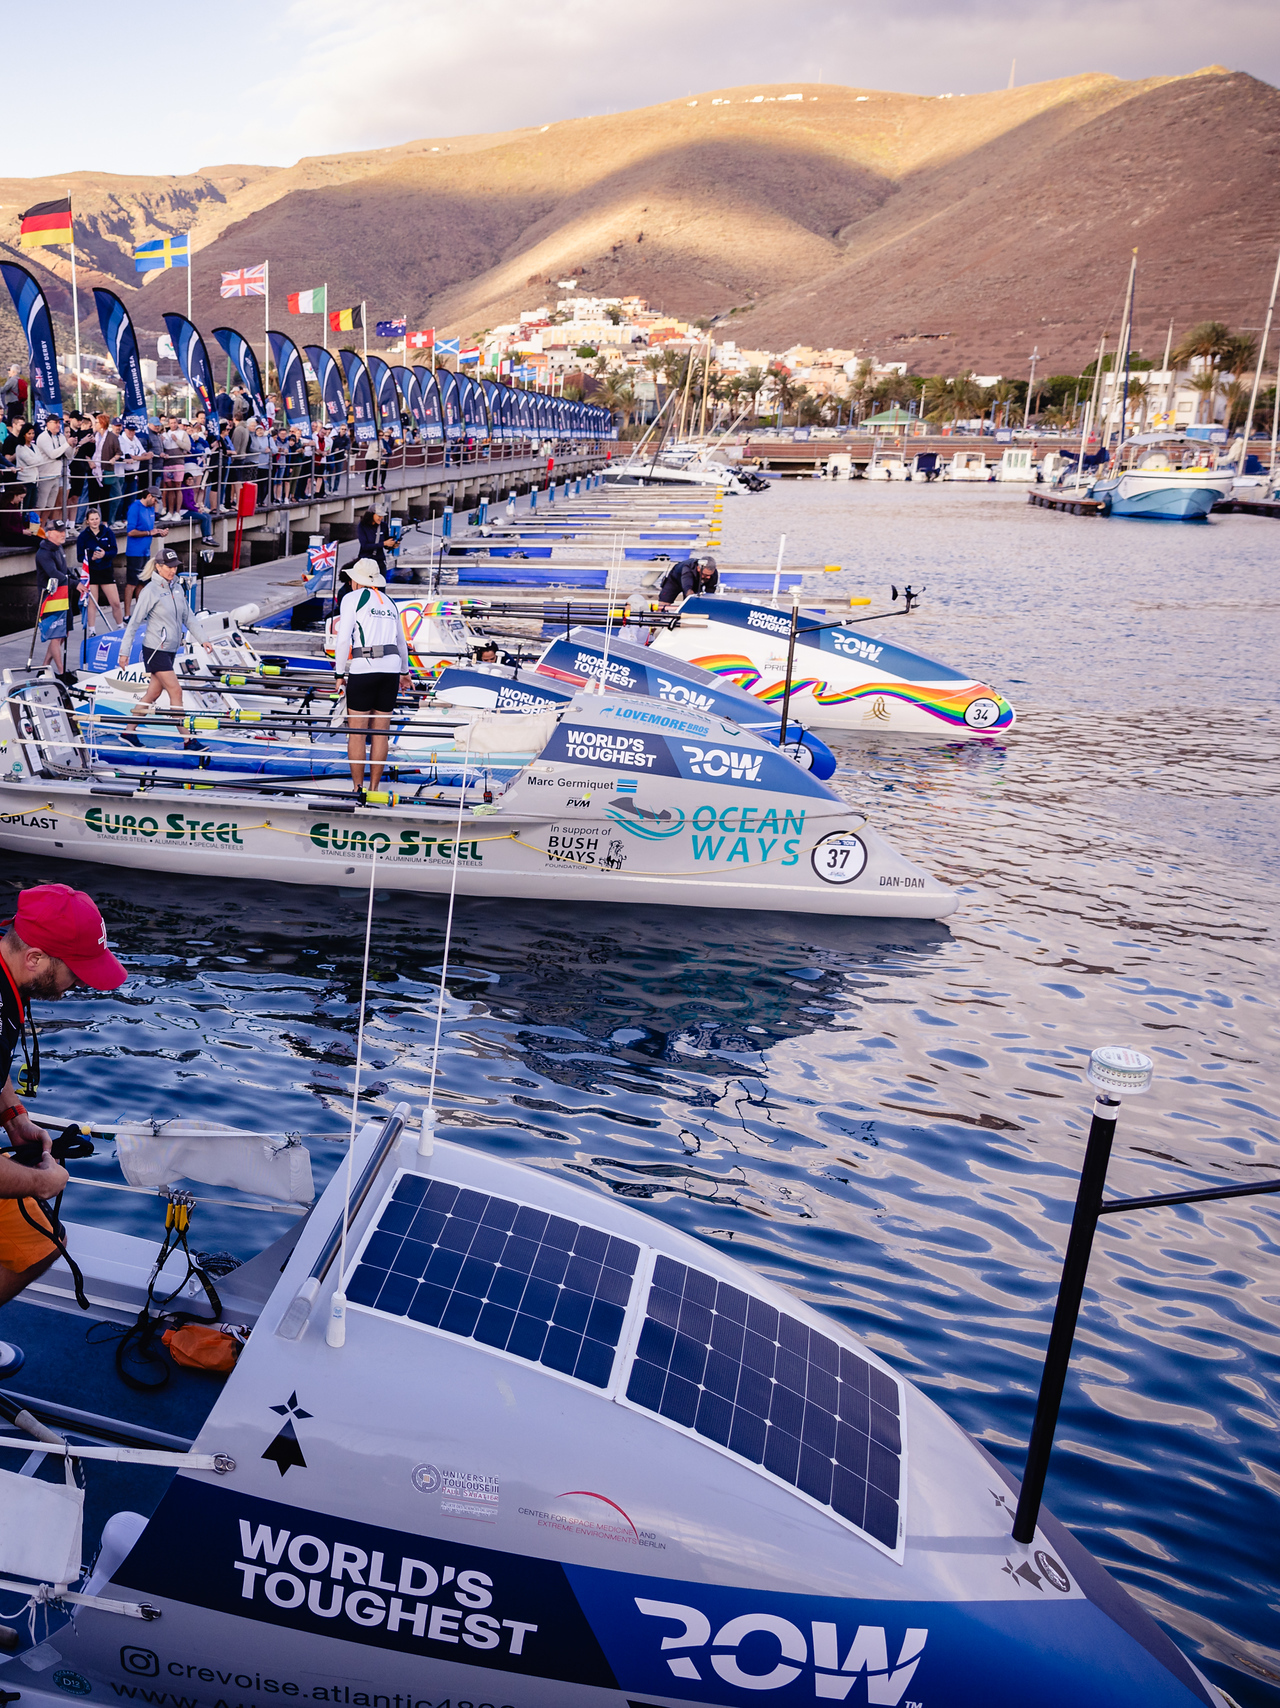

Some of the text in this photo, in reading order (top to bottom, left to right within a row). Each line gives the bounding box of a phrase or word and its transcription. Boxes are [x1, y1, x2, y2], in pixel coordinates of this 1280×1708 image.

[831, 631, 881, 660] ROW
[574, 660, 637, 689] TOUGHEST
[577, 652, 631, 676] WORLD'S
[500, 686, 556, 712] WORLD'S
[656, 678, 716, 712] ROW
[616, 708, 688, 731] LOVEMORE
[687, 723, 709, 734] BROS
[973, 708, 988, 722] 34
[568, 730, 644, 752] WORLD'S
[566, 744, 656, 768] TOUGHEST
[682, 745, 764, 782] ROW
[528, 776, 614, 791] Marc Germiquet
[566, 799, 590, 808] PVM
[84, 808, 244, 844] EURO STEEL
[550, 824, 612, 836] In support of
[692, 806, 806, 835] OCEAN
[96, 834, 128, 842] STAINLESS
[130, 836, 148, 844] STEEL
[310, 823, 483, 860] EURO STEEL
[548, 836, 599, 850] BUSH
[692, 834, 800, 866] WAYS
[321, 850, 356, 858] STAINLESS
[357, 852, 376, 860] STEE
[385, 855, 422, 863] ALUMINIUM
[547, 850, 595, 864] WAYS
[826, 849, 850, 869] 37
[880, 876, 925, 888] DAN-DAN
[442, 1470, 499, 1485] UNIVERSITÉ
[443, 1478, 499, 1493] TOULOUSE III
[442, 1487, 499, 1502] PAUL SABATIER
[518, 1507, 656, 1540] CENTER FOR SPACE MEDICINE AND
[537, 1520, 666, 1550] EXTREME ENVIRONMENTS BERLIN
[238, 1518, 494, 1610] WORLD'S
[233, 1560, 538, 1656] TOUGHEST
[634, 1597, 928, 1706] ROW
[167, 1660, 516, 1708] crevoise.atlantic4
